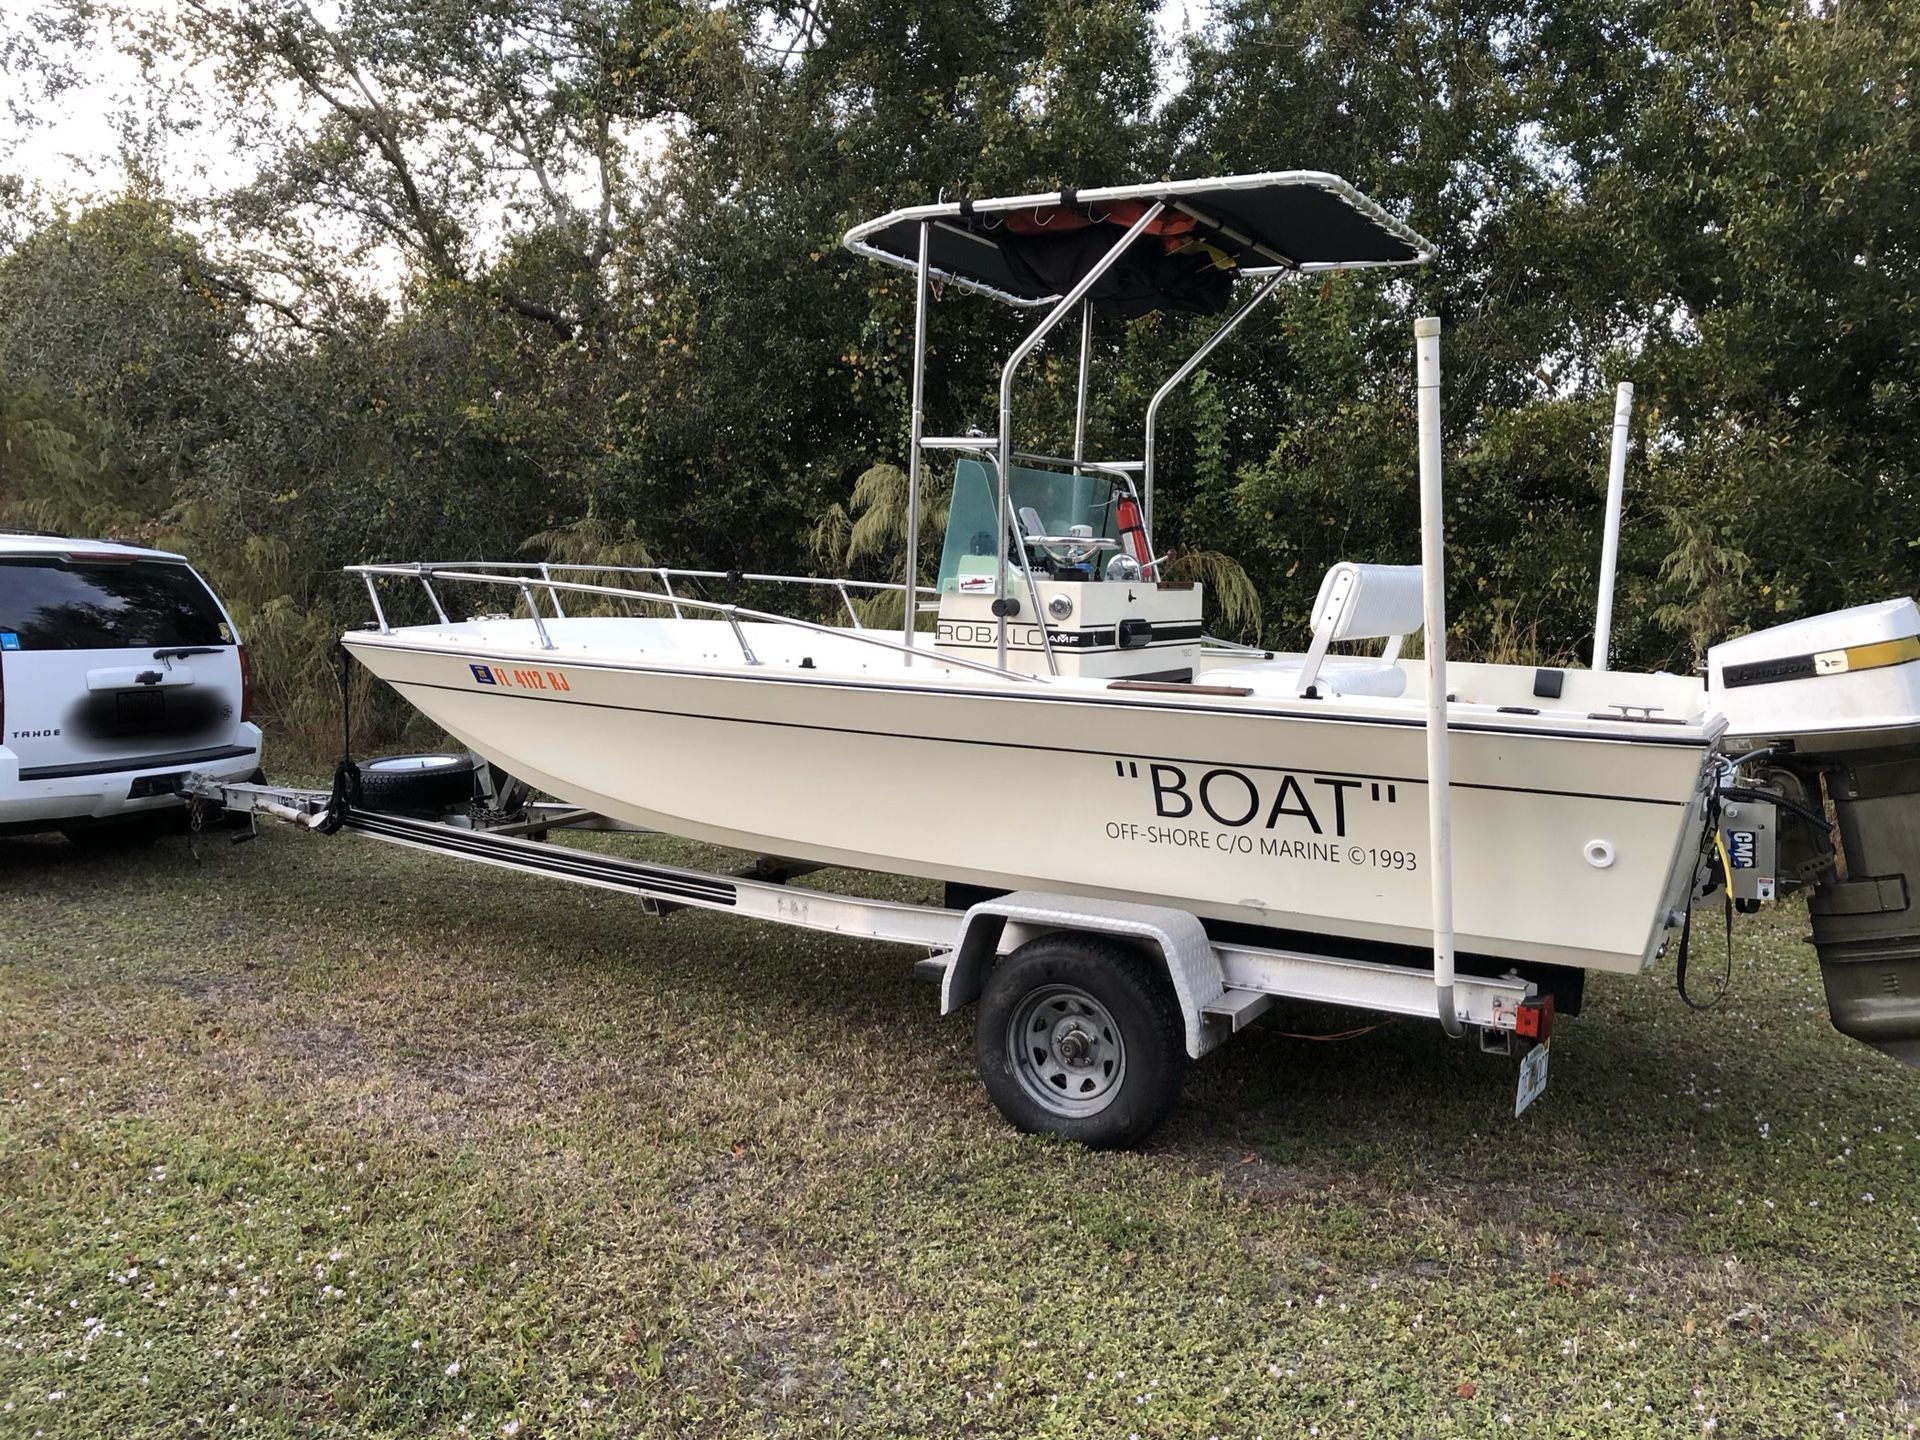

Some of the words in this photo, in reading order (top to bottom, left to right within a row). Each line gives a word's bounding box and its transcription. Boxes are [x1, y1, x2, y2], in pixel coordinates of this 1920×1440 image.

[1049, 634, 1079, 643] AMF
[494, 668, 512, 687] FL
[514, 670, 547, 689] 4112
[546, 671, 570, 691] RJ
[12, 729, 61, 739] TAHOE
[1115, 760, 1397, 837] "BOAT"
[1105, 821, 1211, 849] OFF-SHORE
[1216, 833, 1252, 855] C/O
[1260, 838, 1341, 863] MARINE
[1734, 832, 1753, 868] CMC
